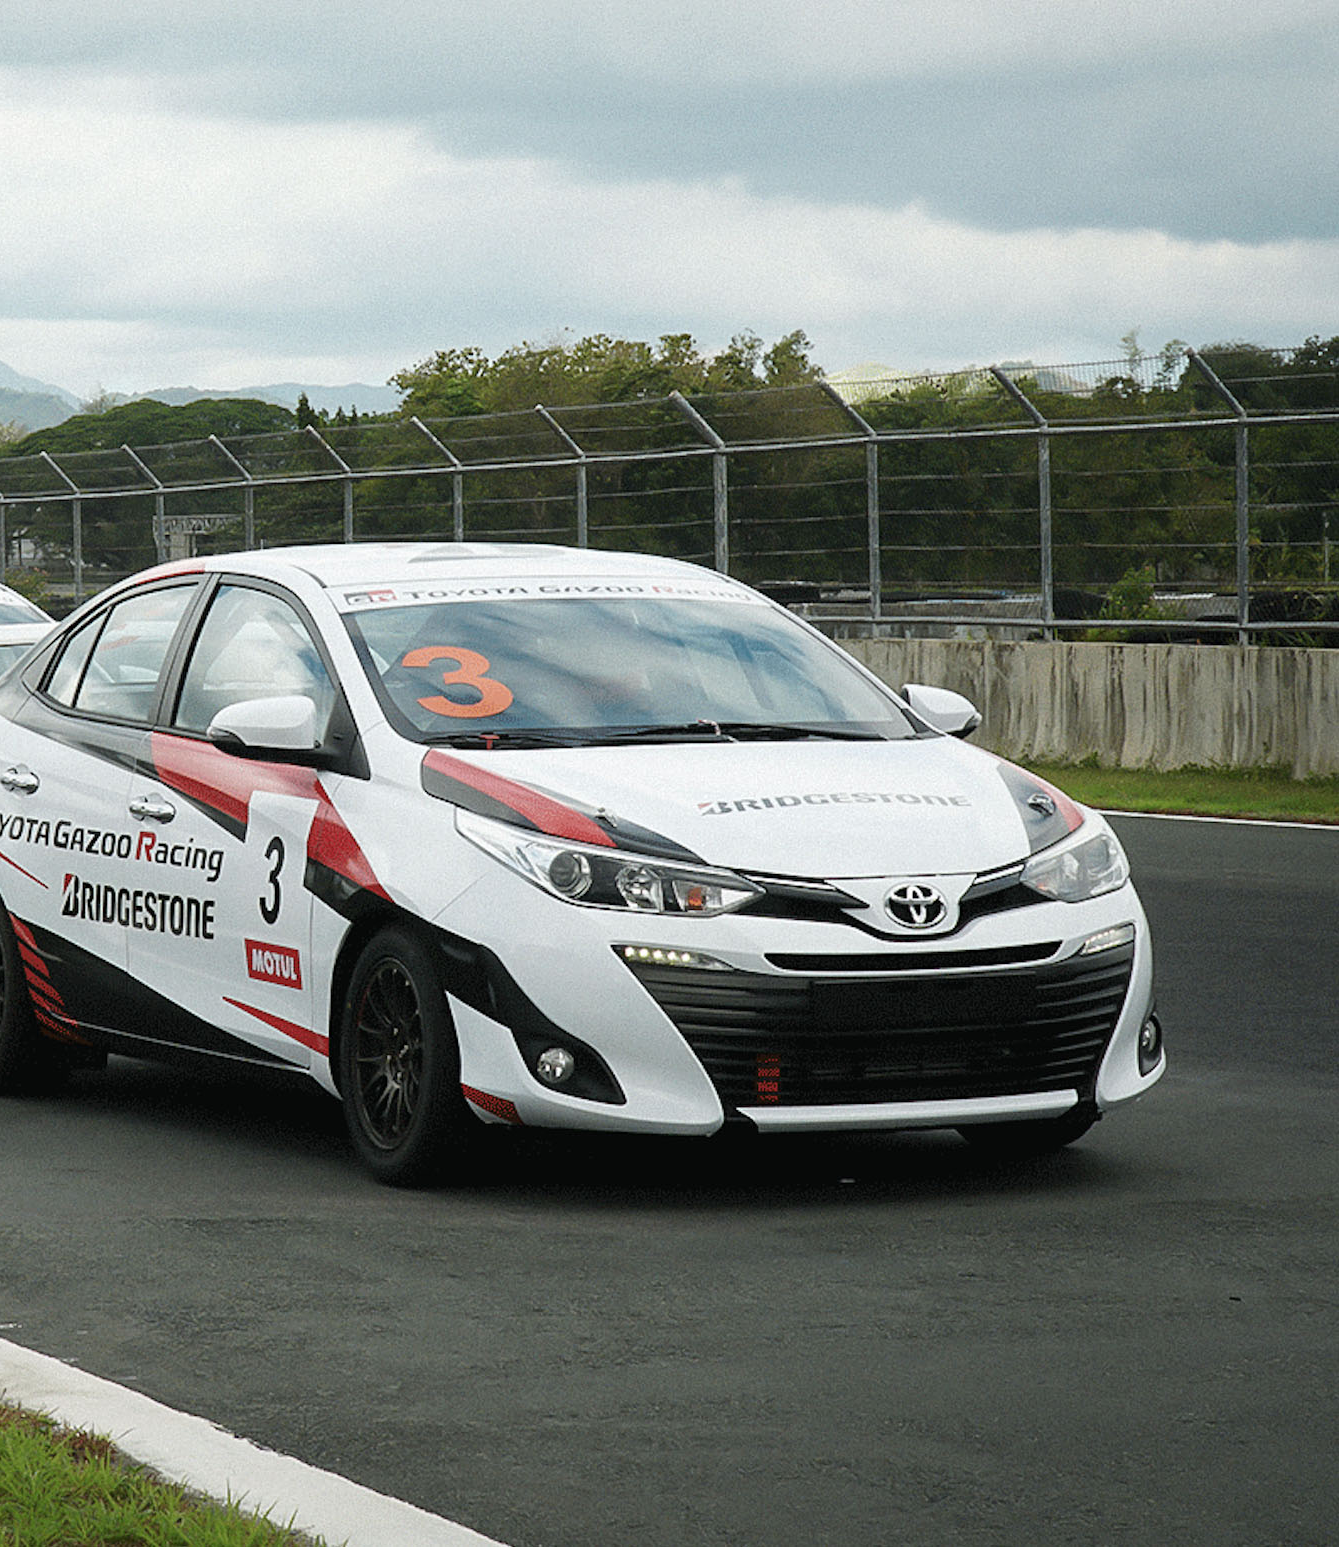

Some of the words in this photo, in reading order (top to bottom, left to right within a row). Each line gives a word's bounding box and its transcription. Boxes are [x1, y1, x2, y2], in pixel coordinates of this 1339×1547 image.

[404, 586, 529, 599] TOYOTA
[539, 585, 644, 594] GAZOO
[652, 585, 751, 600] Racing
[401, 646, 514, 718] 3
[697, 793, 972, 816] BRIDGESTONE
[52, 820, 132, 859] GAZOO
[135, 831, 224, 882] Racing
[259, 836, 285, 924] 3
[62, 873, 215, 939] BRIDGESTONE
[251, 948, 298, 981] MOTUL
